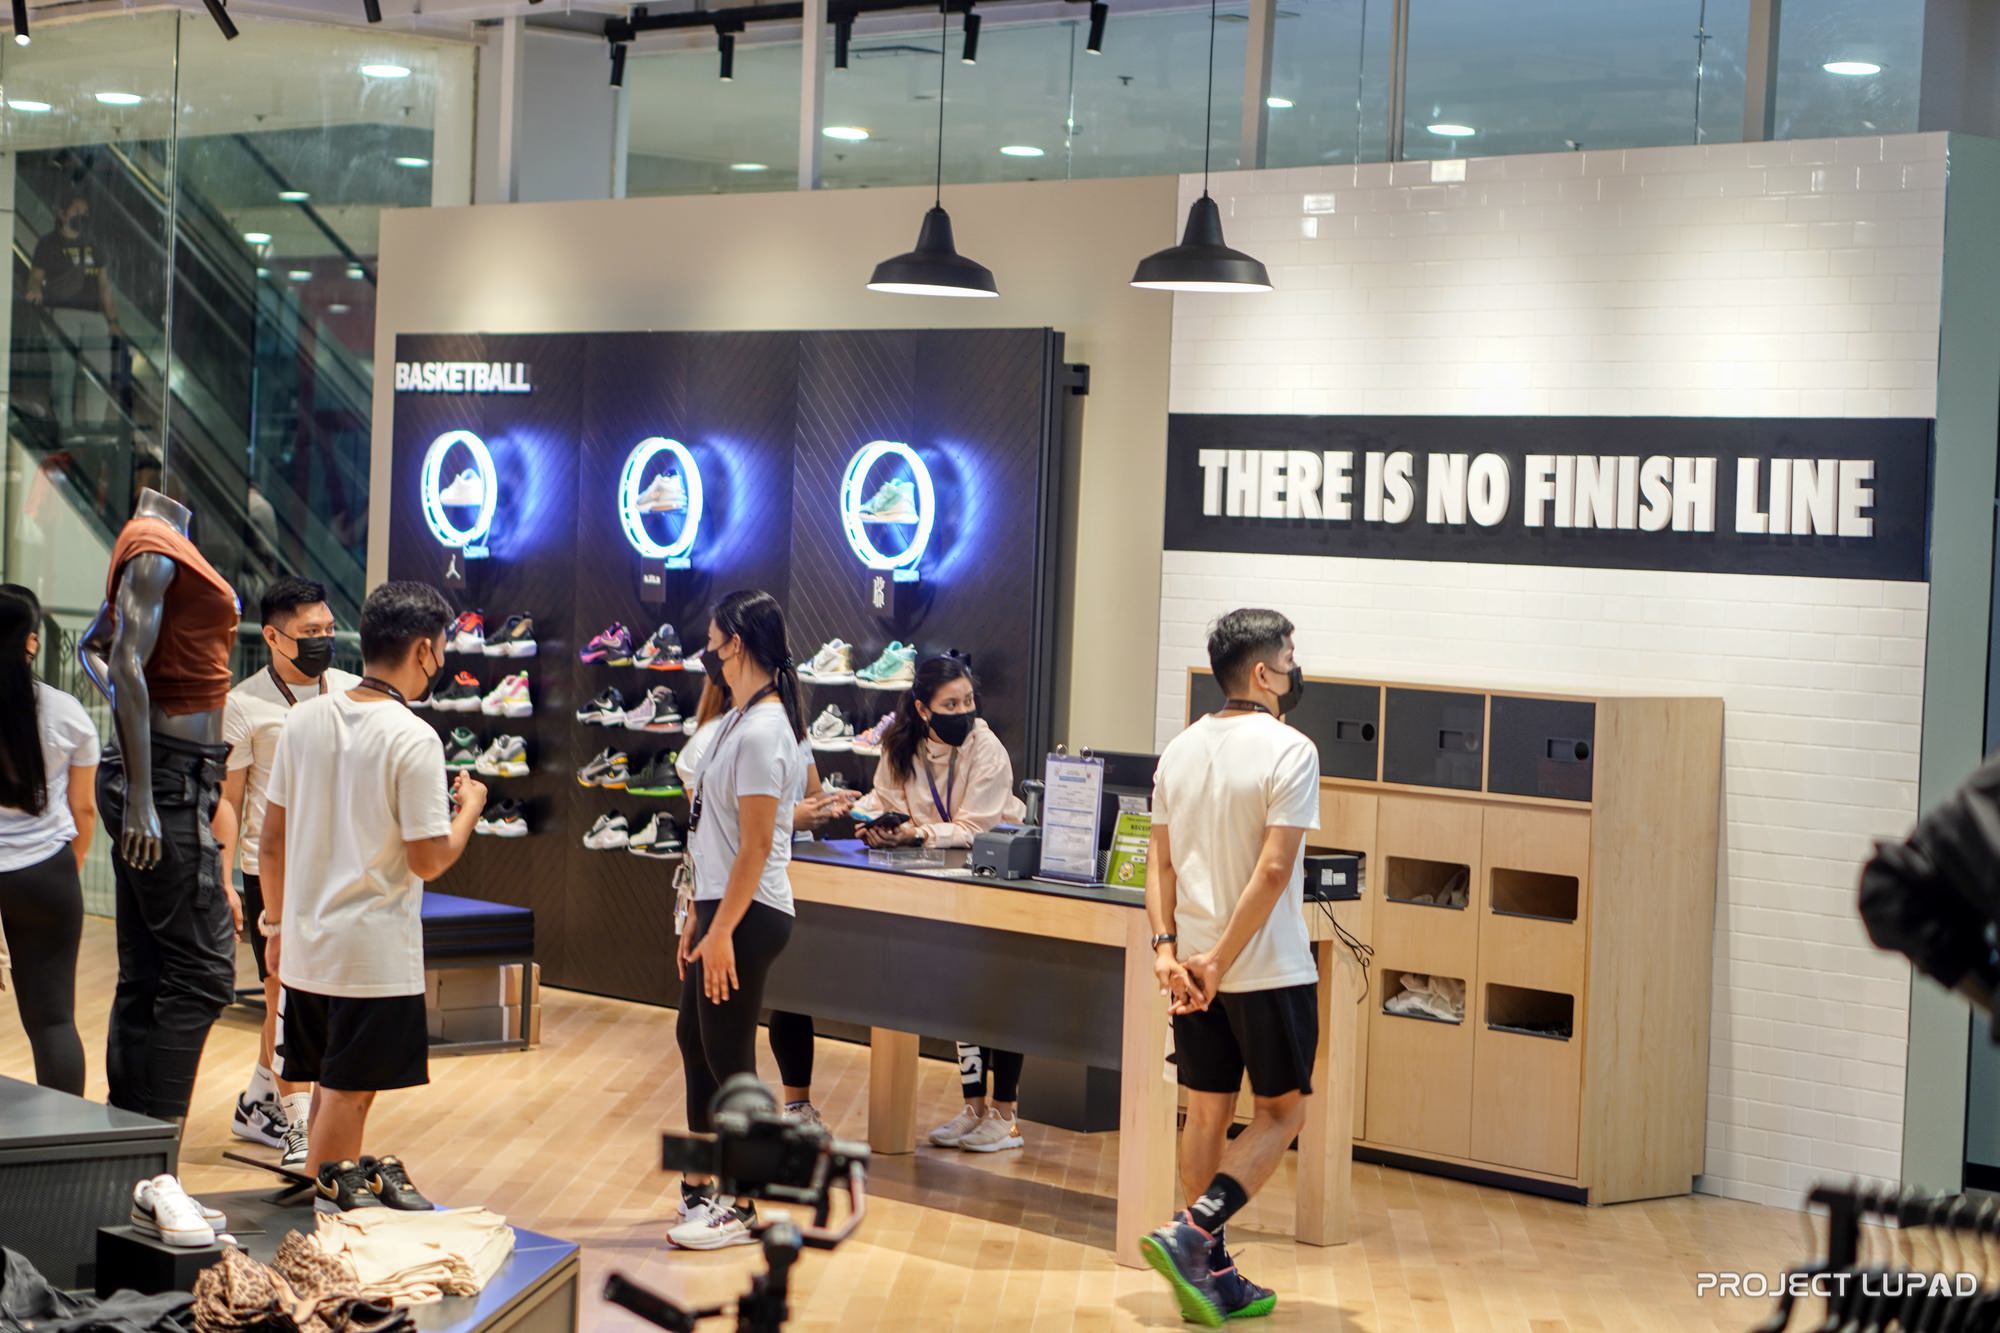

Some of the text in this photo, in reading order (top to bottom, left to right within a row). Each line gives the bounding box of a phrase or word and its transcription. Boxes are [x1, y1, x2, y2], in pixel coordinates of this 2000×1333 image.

[395, 361, 531, 391] BASKETBALL
[1199, 448, 1874, 537] THERE IS NO FINISH LINE
